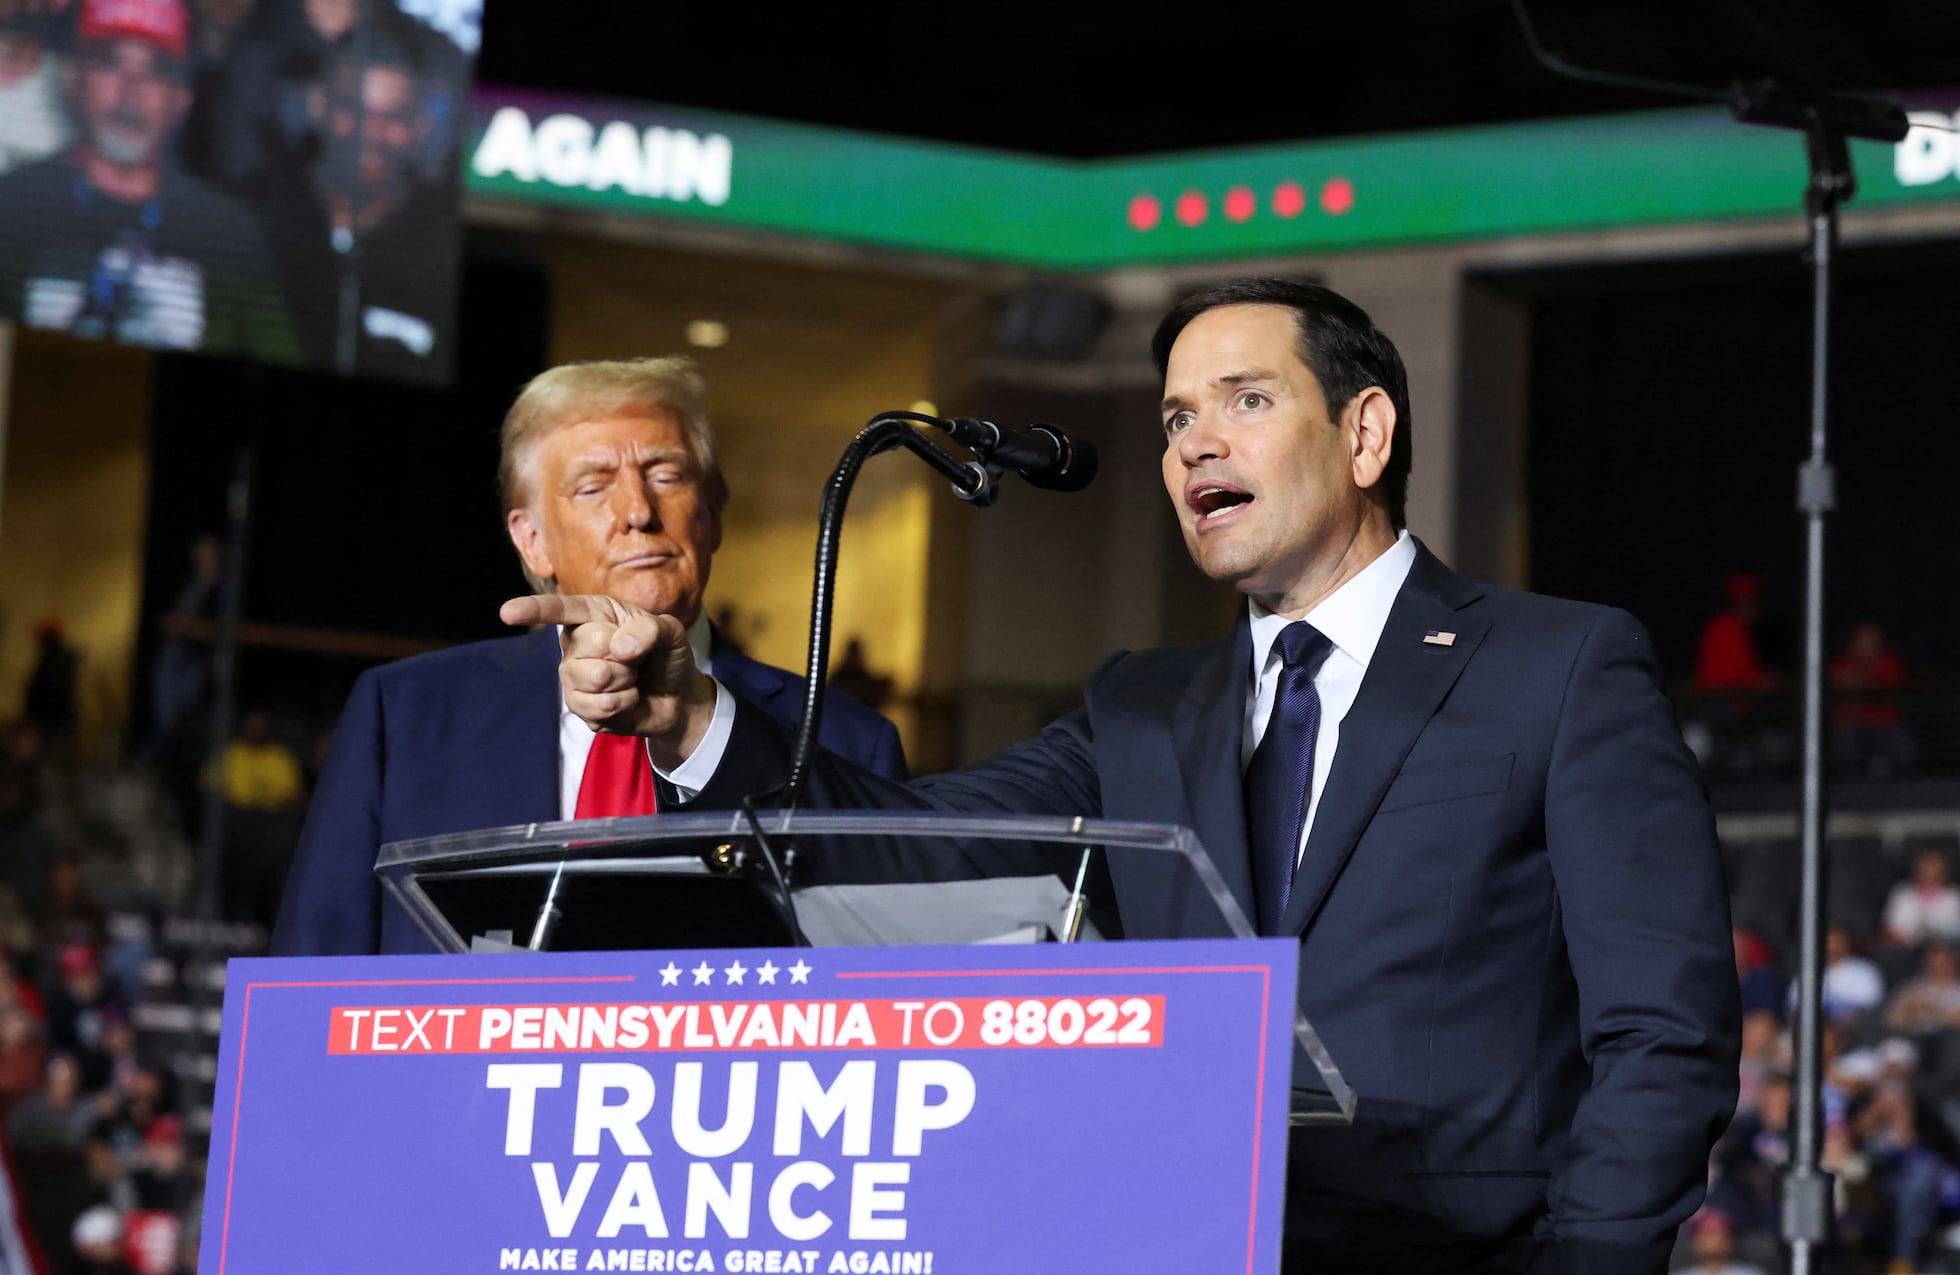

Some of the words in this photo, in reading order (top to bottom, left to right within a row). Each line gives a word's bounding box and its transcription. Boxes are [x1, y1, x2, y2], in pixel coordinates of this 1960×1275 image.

[472, 106, 733, 206] AGAIN
[342, 1008, 466, 1051] TEXT
[478, 1003, 877, 1049] PENNSYLVANIA
[893, 1000, 965, 1046] TO
[979, 998, 1152, 1046] 88022
[486, 1059, 977, 1158] TRUMP
[531, 1160, 911, 1241] VANCE
[499, 1248, 578, 1271] MAKE
[585, 1248, 715, 1273] AMERICA
[724, 1249, 819, 1274] GREAT
[827, 1250, 934, 1275] AGAIN!
